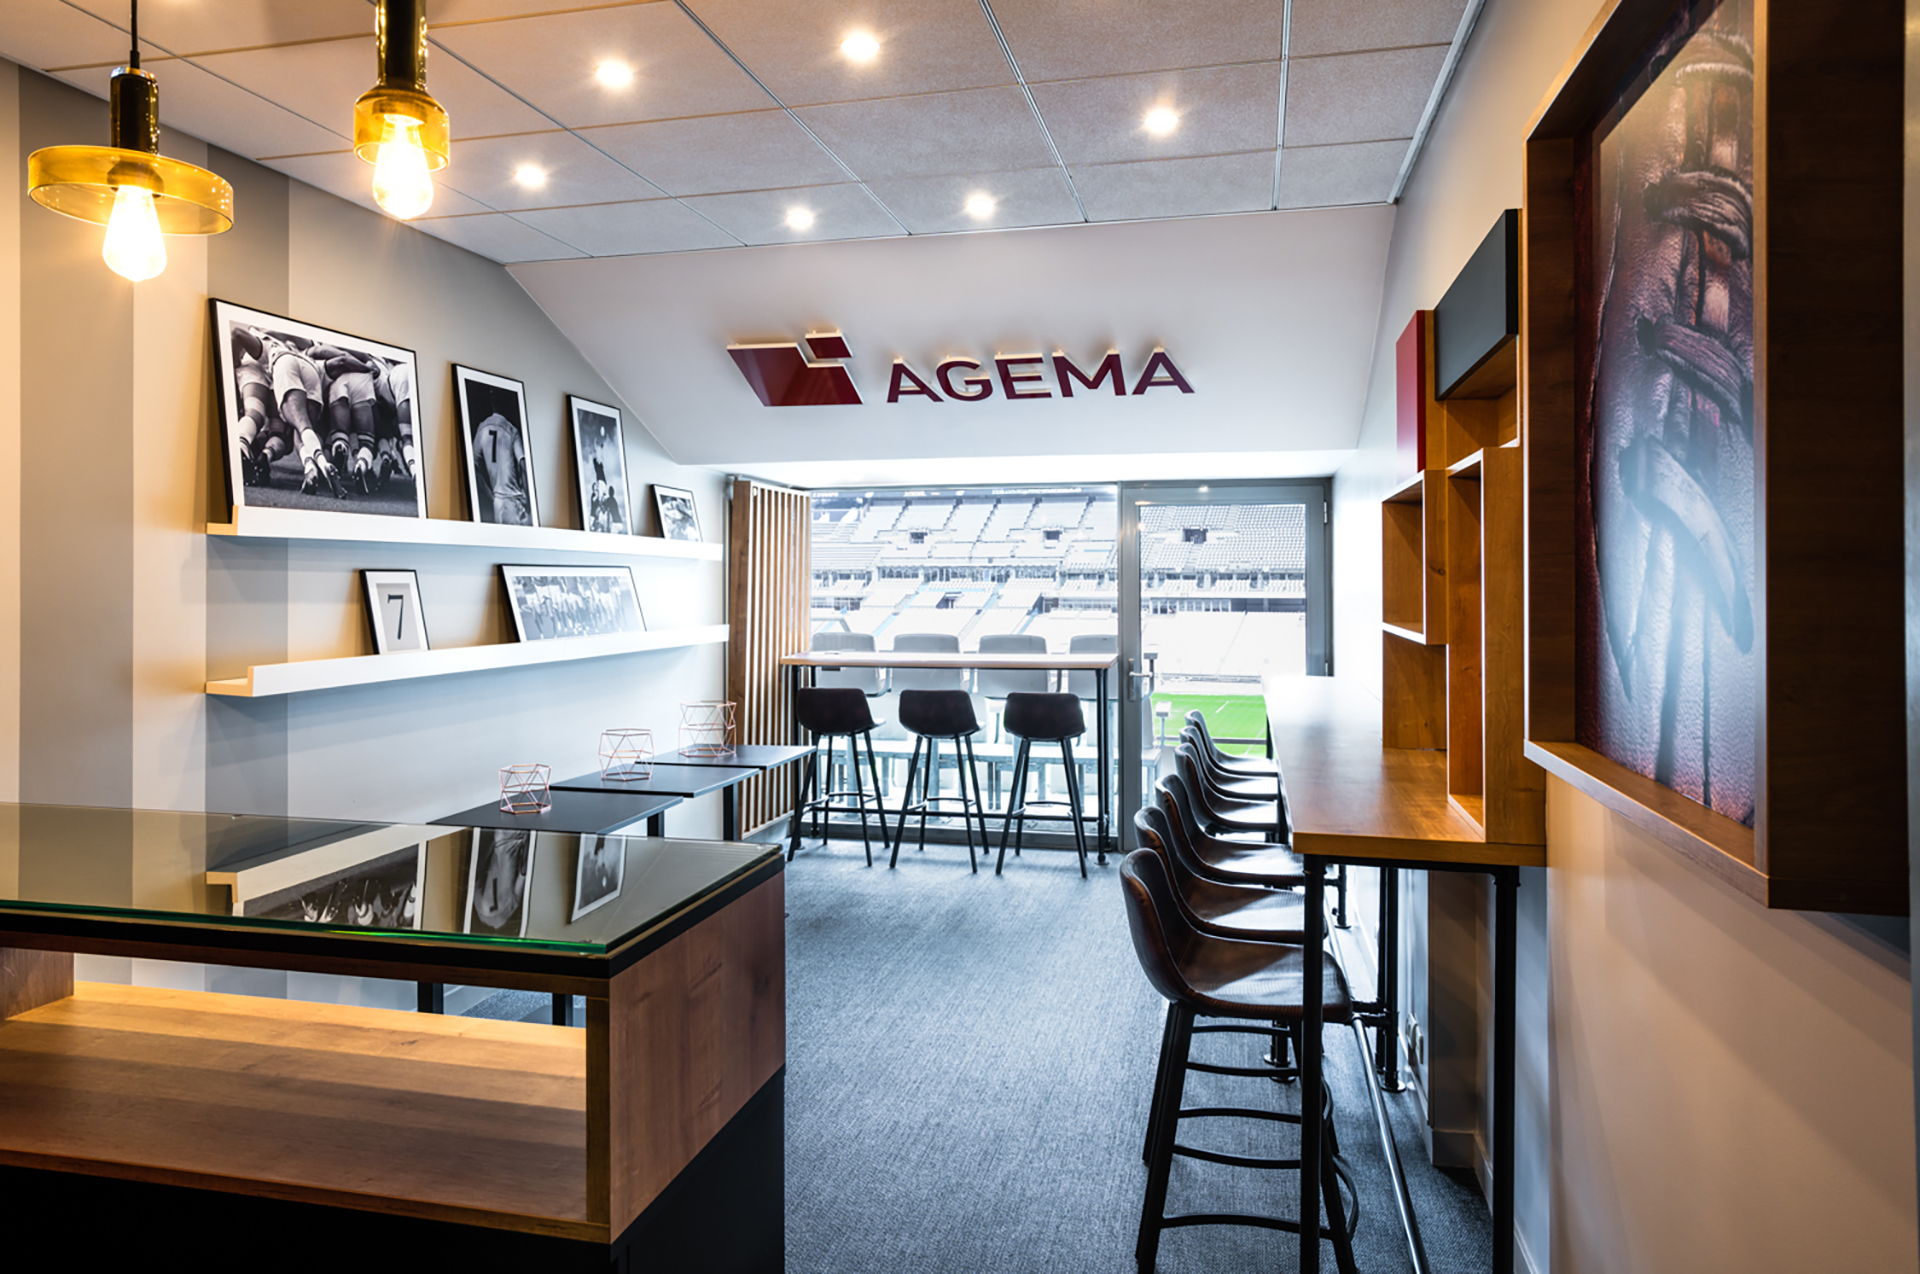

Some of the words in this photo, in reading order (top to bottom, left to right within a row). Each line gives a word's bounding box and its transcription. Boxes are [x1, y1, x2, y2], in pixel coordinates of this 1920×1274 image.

[886, 348, 1195, 403] AGEMA
[488, 429, 498, 464] 7
[387, 593, 404, 640] 7
